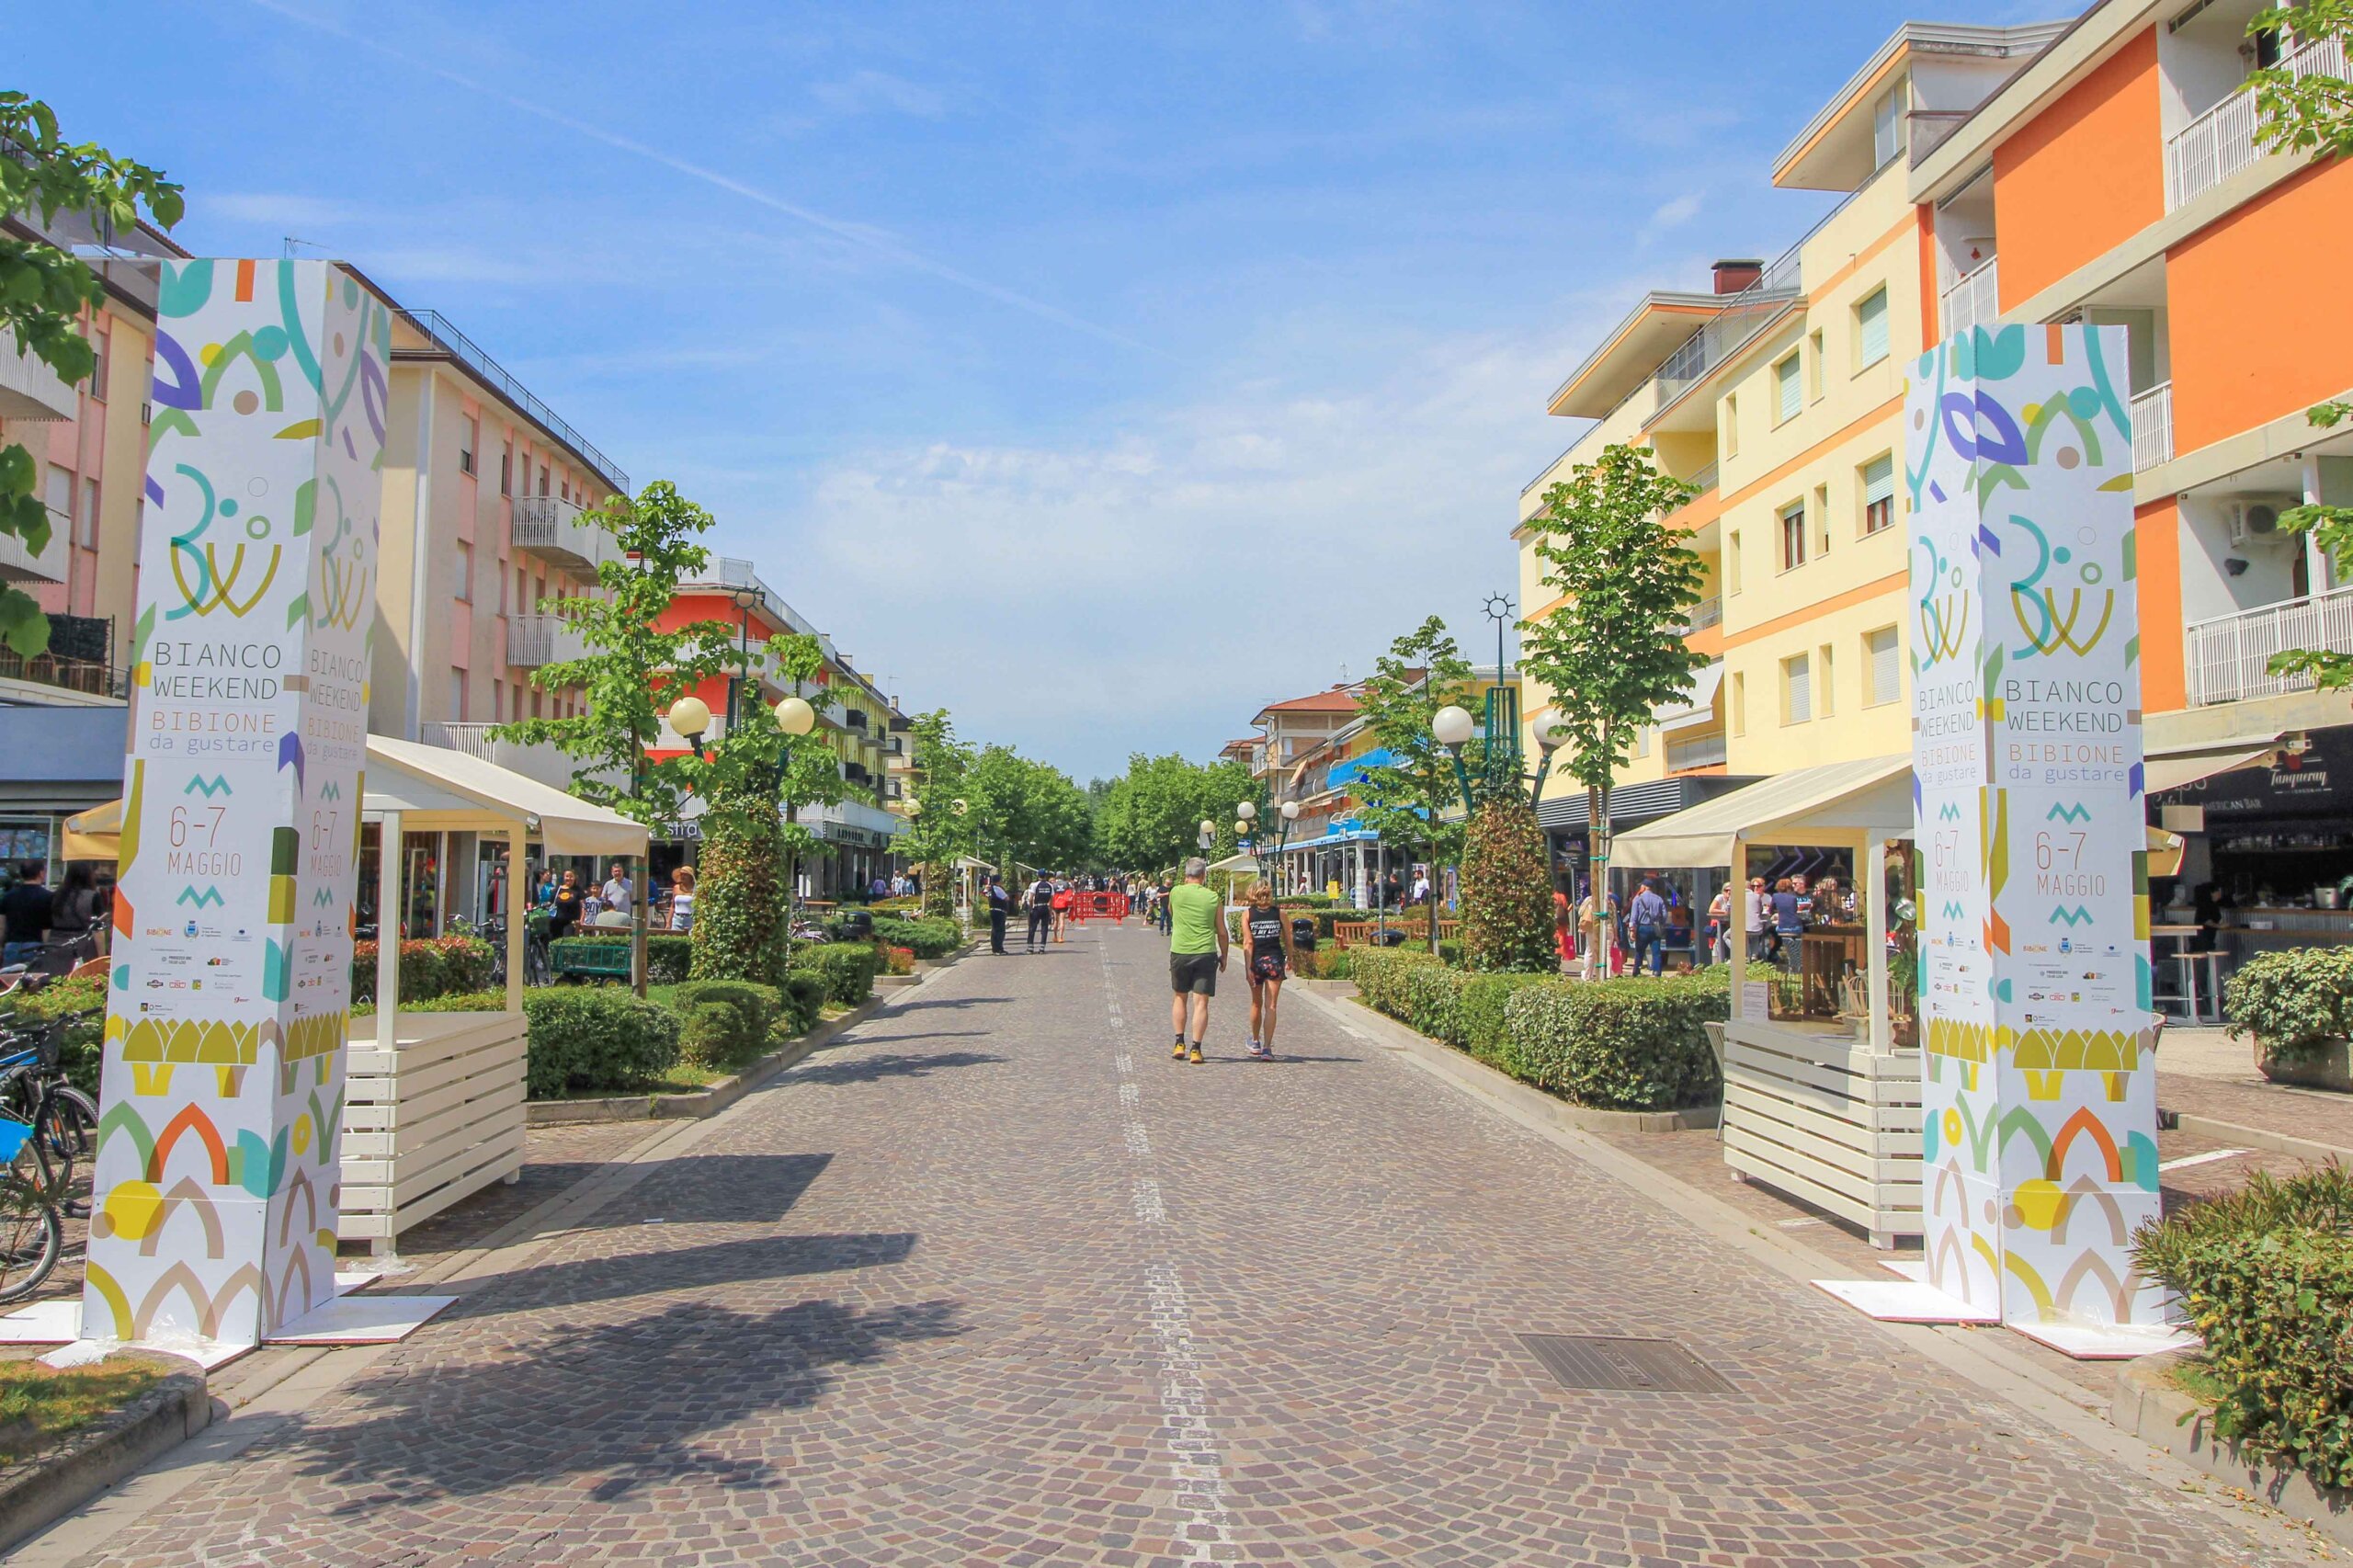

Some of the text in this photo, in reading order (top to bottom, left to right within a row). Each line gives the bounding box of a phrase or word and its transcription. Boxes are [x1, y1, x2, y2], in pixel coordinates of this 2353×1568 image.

[154, 642, 281, 668] BIANCO
[310, 649, 363, 684] BIANCO
[153, 676, 278, 699] WEEKEND
[309, 682, 360, 712] WEEKEND
[1919, 680, 1974, 711] BIANCO
[2006, 679, 2122, 705] BIANCO
[152, 710, 276, 733] BIBIONE
[307, 716, 359, 744] BIBIONE
[1919, 710, 1974, 738] WEEKEND
[2006, 710, 2122, 733] WEEKEND
[150, 733, 274, 755] da gustare
[306, 741, 358, 761] da gustare
[1921, 743, 1975, 767] BIBIONE
[2009, 744, 2124, 765] BIBIONE
[1922, 765, 1977, 785] da gustare
[2008, 764, 2125, 784] da gustare
[2269, 769, 2326, 788] Tanqueray
[170, 805, 226, 847] 6-7
[313, 810, 337, 851] 6-7
[1935, 830, 1959, 868] 6-7
[2036, 831, 2086, 871] 6-7
[167, 851, 242, 877] MAGGIO
[311, 854, 342, 878] MAGGIO
[1936, 870, 1969, 892] MAGGIO
[2037, 873, 2105, 897] MAGGIO
